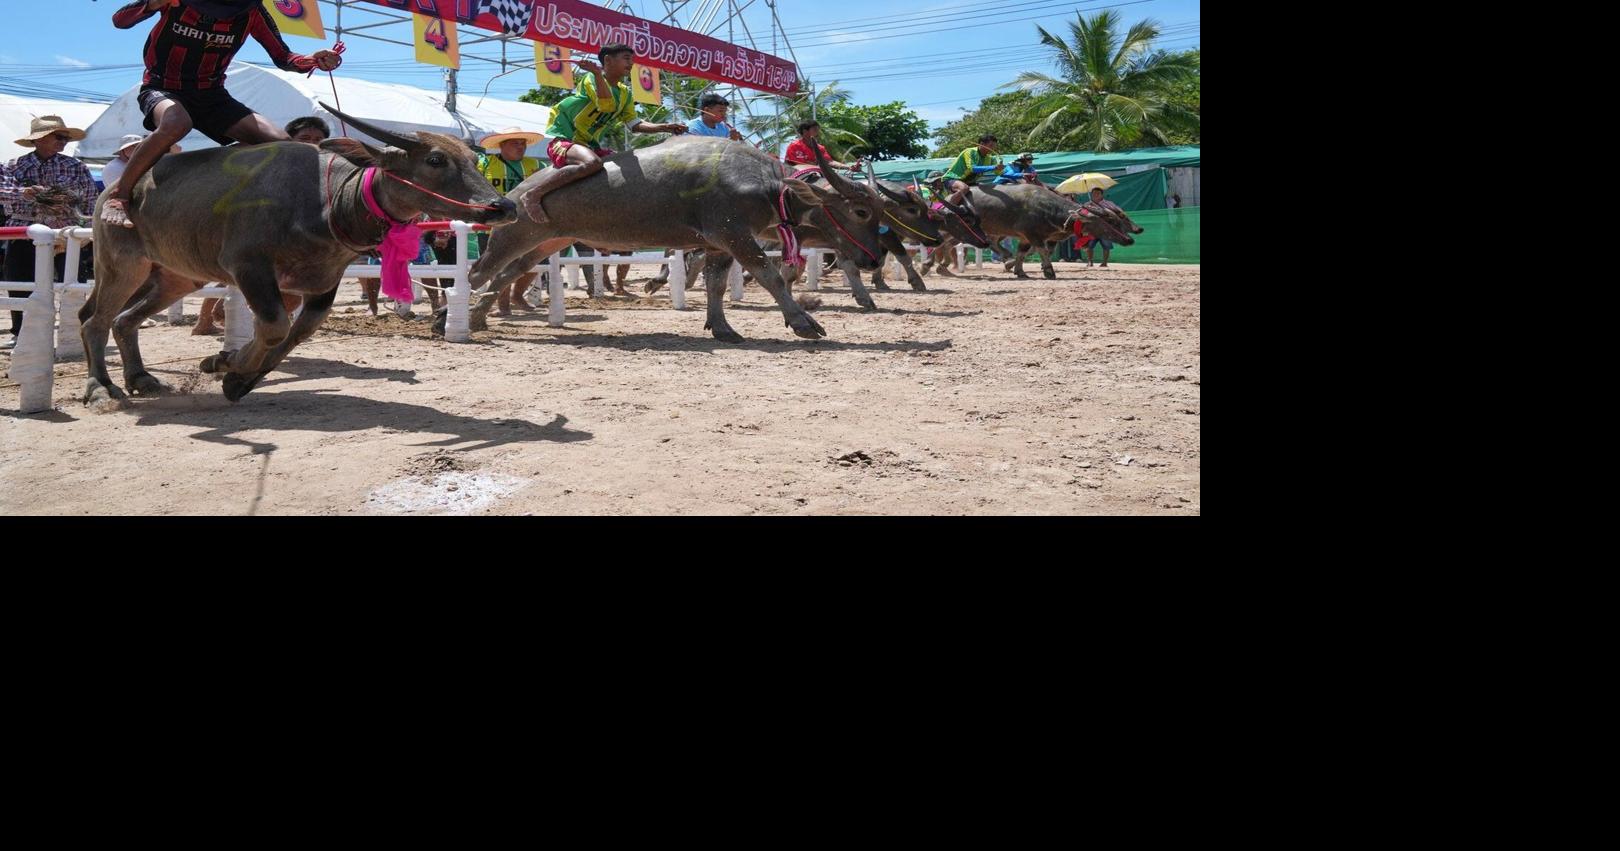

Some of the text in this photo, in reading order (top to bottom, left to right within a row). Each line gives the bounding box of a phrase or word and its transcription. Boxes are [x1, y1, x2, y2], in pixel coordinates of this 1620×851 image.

[172, 22, 235, 44] CHAIYAN
[424, 17, 449, 51] 4
[543, 41, 563, 74] 5
[639, 64, 654, 91] 6
